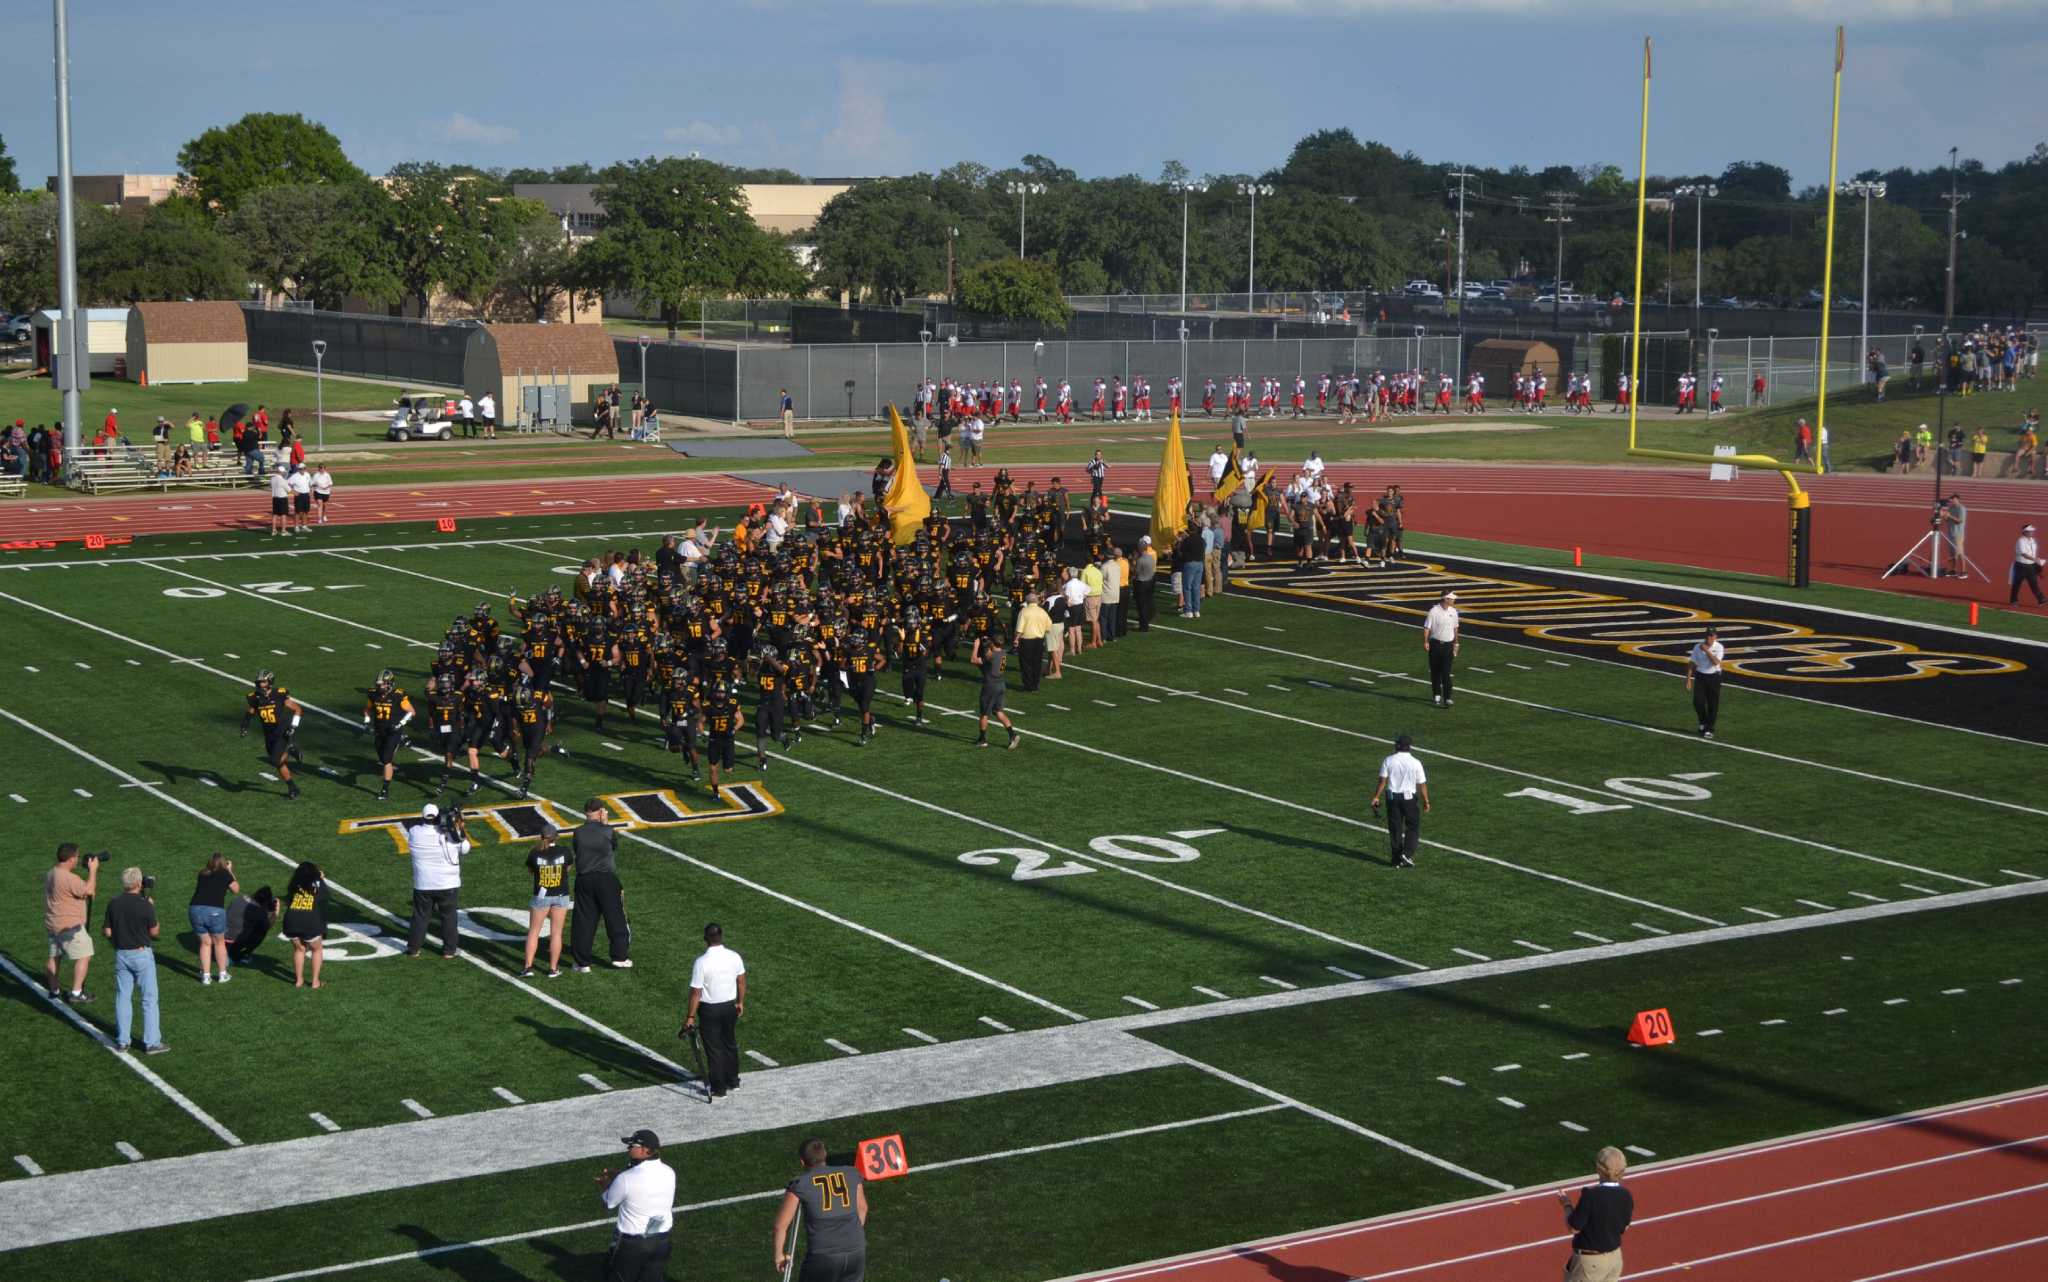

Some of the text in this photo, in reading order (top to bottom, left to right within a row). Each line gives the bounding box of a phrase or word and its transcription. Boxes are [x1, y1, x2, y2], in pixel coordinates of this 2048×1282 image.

[441, 519, 454, 530] 10
[90, 535, 104, 547] 20
[163, 581, 315, 599] 20
[1503, 777, 1712, 815] 10
[957, 835, 1201, 881] 20
[1645, 1012, 1668, 1039] 20
[865, 1139, 901, 1174] 30
[812, 1172, 850, 1211] 74
